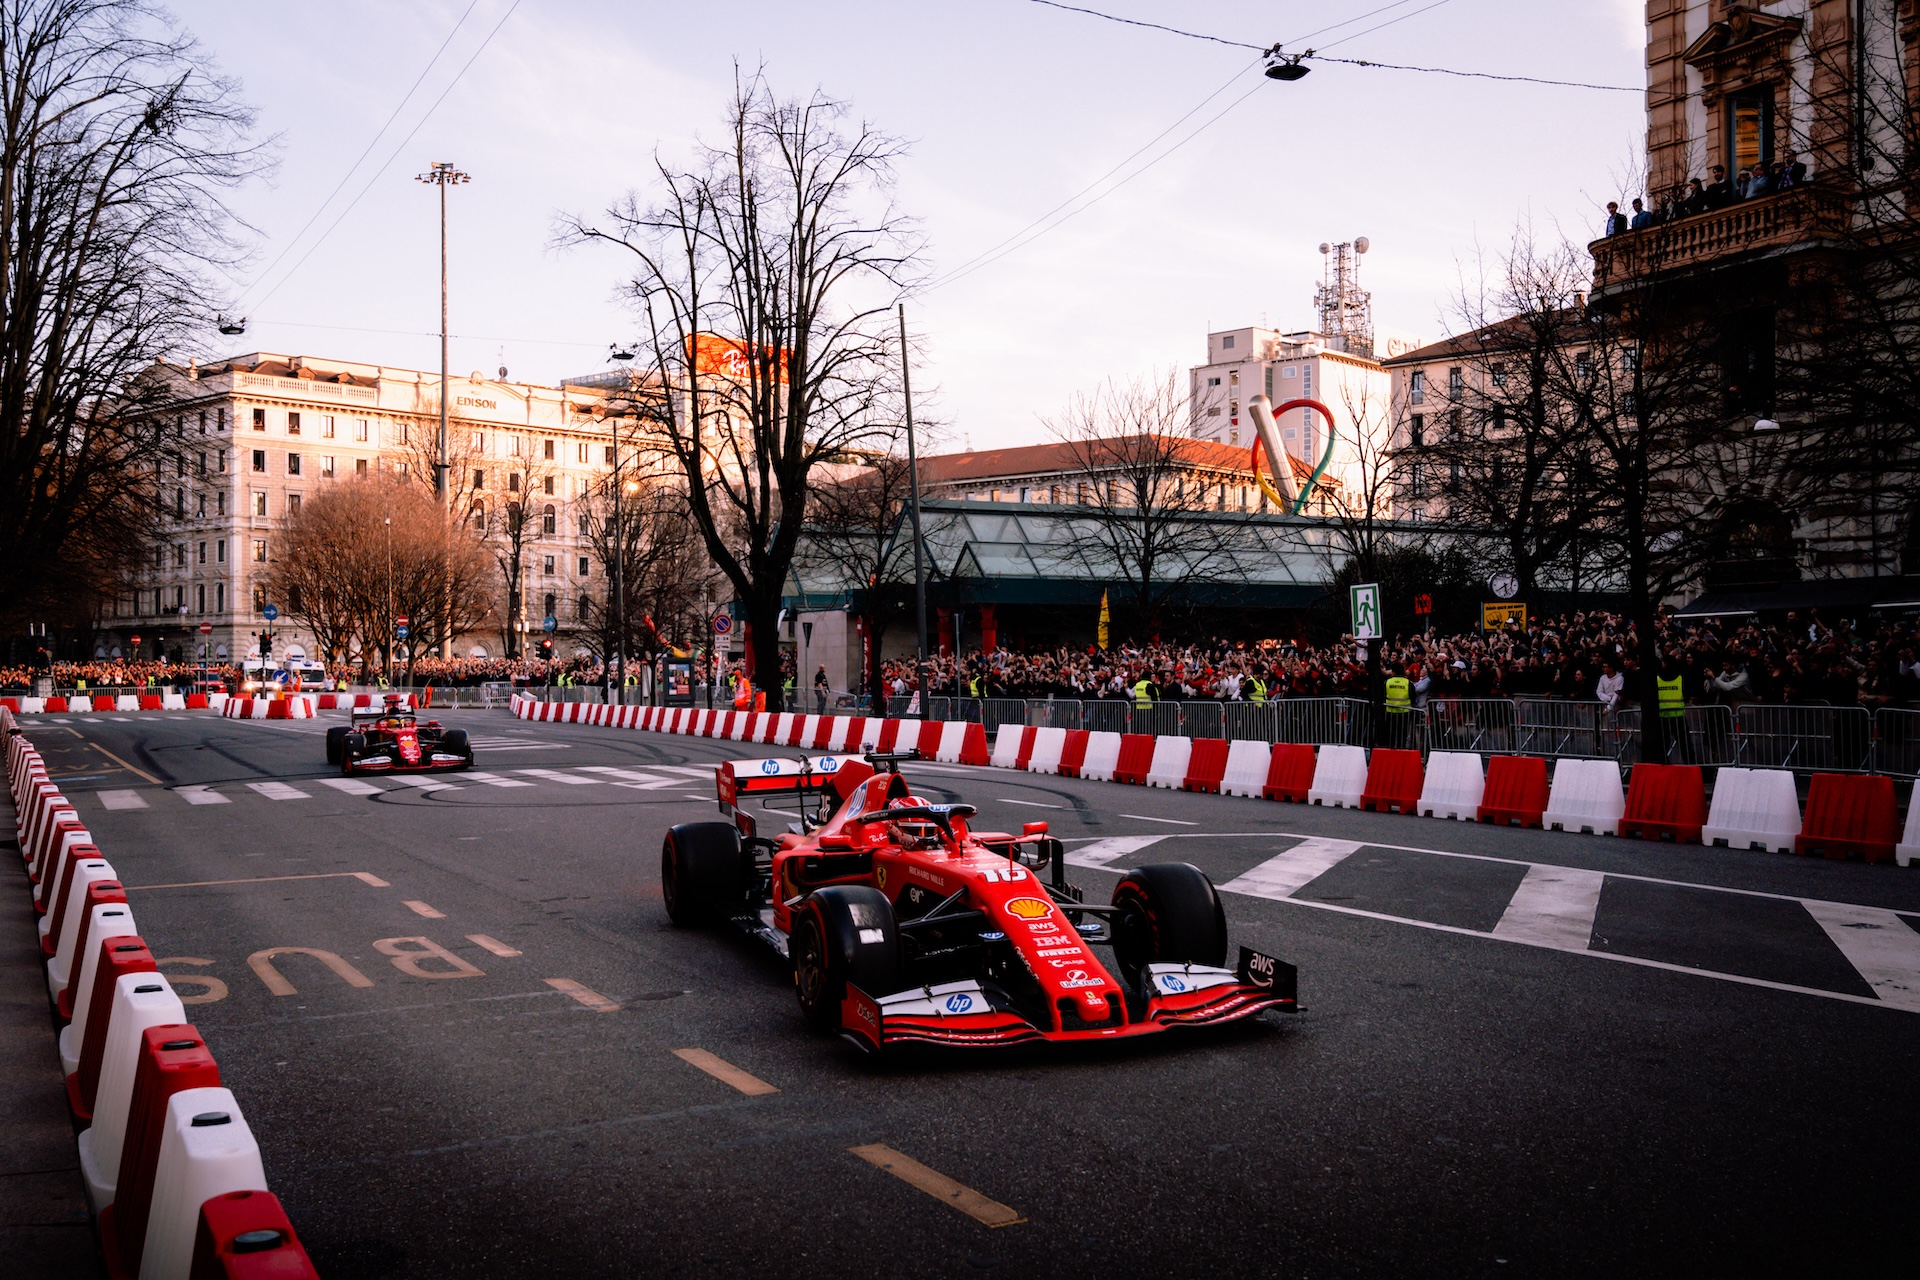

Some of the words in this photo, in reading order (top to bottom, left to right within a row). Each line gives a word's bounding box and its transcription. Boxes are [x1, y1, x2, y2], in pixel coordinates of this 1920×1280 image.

[456, 396, 497, 410] EDISON
[763, 760, 779, 774] hp
[822, 757, 836, 771] hp
[976, 867, 1018, 883] 16
[1028, 921, 1057, 931] aws
[1033, 935, 1072, 946] IBM
[156, 936, 487, 1005] BUS
[1249, 953, 1275, 975] aws
[1060, 977, 1104, 988] UniCredit
[1165, 975, 1184, 991] hp
[949, 994, 972, 1012] hp
